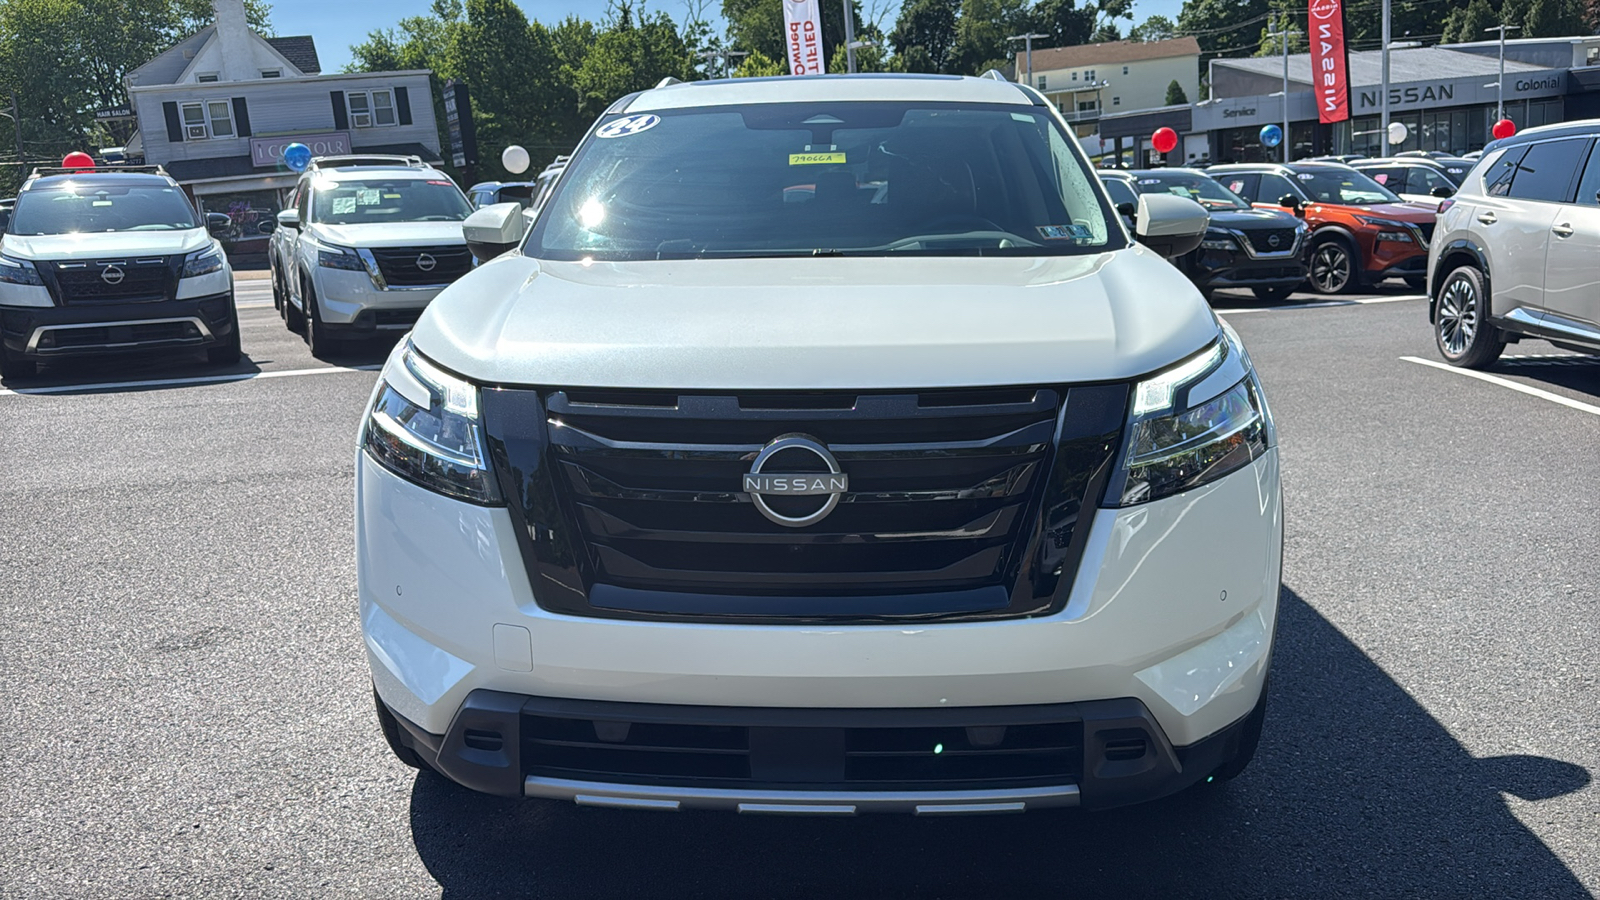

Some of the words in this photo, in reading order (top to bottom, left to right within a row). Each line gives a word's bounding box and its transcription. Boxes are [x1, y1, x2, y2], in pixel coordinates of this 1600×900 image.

[1516, 75, 1560, 91] Colonial
[1360, 83, 1453, 108] NISSAN
[96, 110, 111, 118] HAIR
[111, 109, 131, 117] SALON
[1223, 106, 1256, 118] Service
[602, 114, 655, 136] 24
[268, 140, 344, 160] COTOUR
[746, 477, 845, 491] NISSAN
